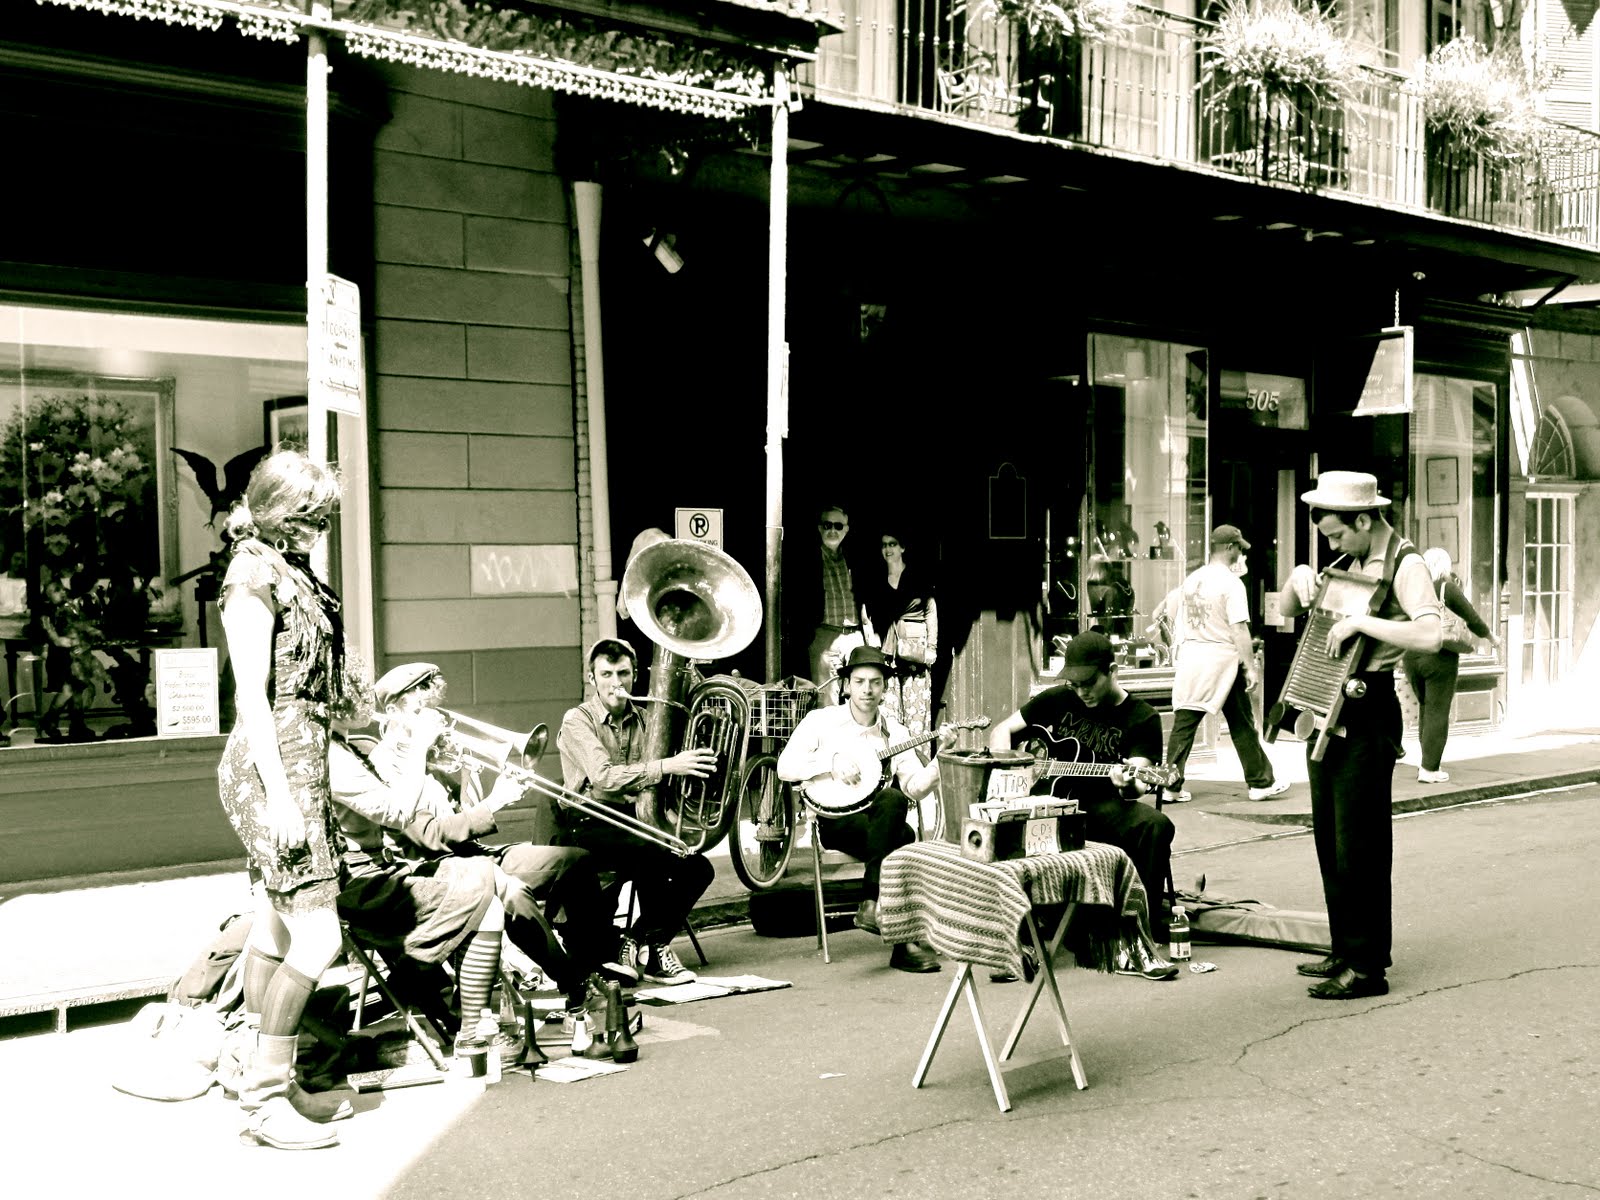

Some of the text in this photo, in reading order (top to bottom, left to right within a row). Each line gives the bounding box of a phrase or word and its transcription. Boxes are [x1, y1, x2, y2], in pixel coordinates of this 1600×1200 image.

[329, 322, 355, 342] CORNER
[329, 353, 356, 372] ANYTIME
[1246, 389, 1280, 411] 505
[1000, 773, 1028, 793] Tips
